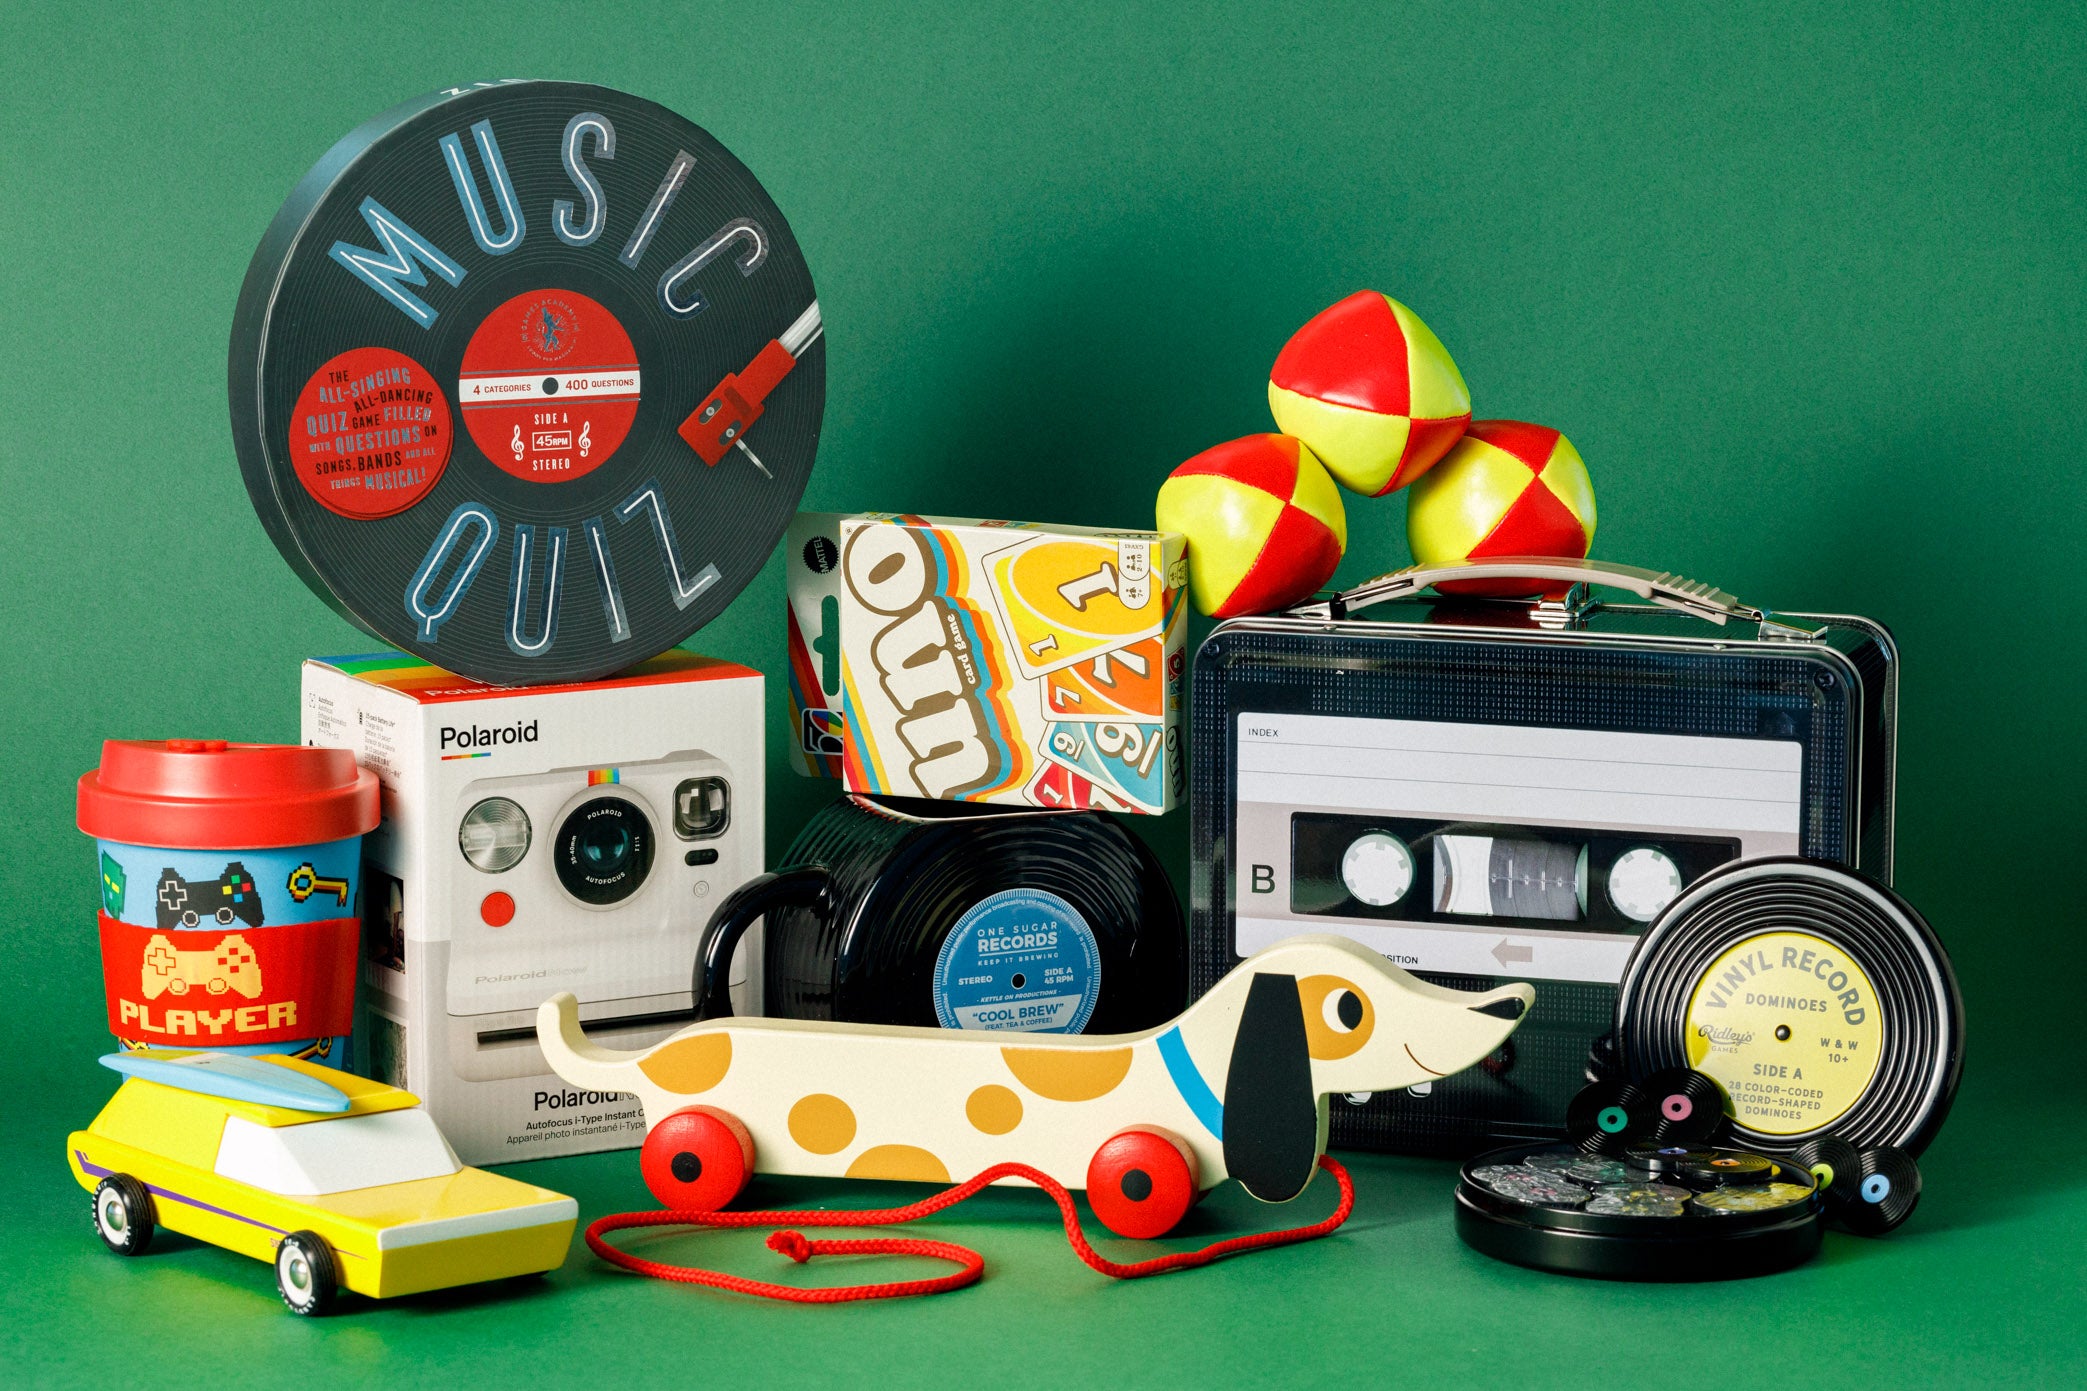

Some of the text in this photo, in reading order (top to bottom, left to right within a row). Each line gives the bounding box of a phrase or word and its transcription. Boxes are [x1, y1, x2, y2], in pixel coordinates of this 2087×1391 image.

[328, 111, 769, 330] MUSIC
[319, 367, 411, 404] ALL-SINGING
[329, 370, 349, 384] THE
[473, 378, 634, 395] 4 CATEGORIES 400 QUESTIONS
[354, 388, 433, 413] ALL-DANCING
[306, 406, 432, 437] QUIZ GAME FILLED
[534, 412, 568, 425] SIDE A
[309, 425, 437, 455] WITH QUESTIONS ON
[536, 435, 568, 447] 45RPM
[358, 450, 402, 471] BANDS
[405, 448, 420, 459] AND
[422, 447, 435, 457] ALL
[532, 458, 570, 471] STEREO
[330, 466, 426, 491] THINGS MUSICAL!
[813, 537, 830, 573] MATTEL
[404, 478, 722, 657] QUIZ
[1057, 561, 1120, 612] 1
[946, 613, 976, 685] card game
[1028, 633, 1060, 658] 1
[1055, 686, 1081, 708] 7
[440, 719, 539, 750] Polaroid
[1248, 728, 1279, 737] INDEX
[1043, 783, 1064, 805] 1
[587, 808, 622, 820] POLAROID
[569, 835, 578, 865] 35-40mm
[585, 871, 626, 885] AUTOFOCUS
[1250, 864, 1275, 896] B
[977, 921, 1058, 938] ONE SUGAR
[978, 932, 1058, 952] RECORDS
[977, 952, 1059, 967] KEEP IT BREWING
[958, 966, 1073, 986] STEREO SIDE A
[1044, 974, 1074, 985] 45 RPM
[1705, 946, 1866, 1026] VINYL RECORD
[980, 989, 1057, 1003] KETTLE ON PRODUCTIONS
[1745, 993, 1827, 1012] DOMINOES
[119, 998, 298, 1035] PLAYER
[1006, 1020, 1019, 1028] TEA
[1026, 1017, 1053, 1026] COFFEE)
[1711, 1045, 1738, 1054] GAMES
[1820, 1037, 1859, 1050] W & W
[1828, 1053, 1849, 1063] 10+
[1753, 1063, 1803, 1080] SIDE A
[1728, 1081, 1823, 1099] 28 COLOR-CODED
[1729, 1092, 1821, 1110] RECORD-SHAPED
[526, 1117, 573, 1131] Autofocus
[574, 1113, 603, 1125] i-Type
[604, 1110, 636, 1121] Instant
[1745, 1105, 1802, 1119] DOMINOES
[506, 1120, 646, 1145] Appareil photo instantané i-Type
